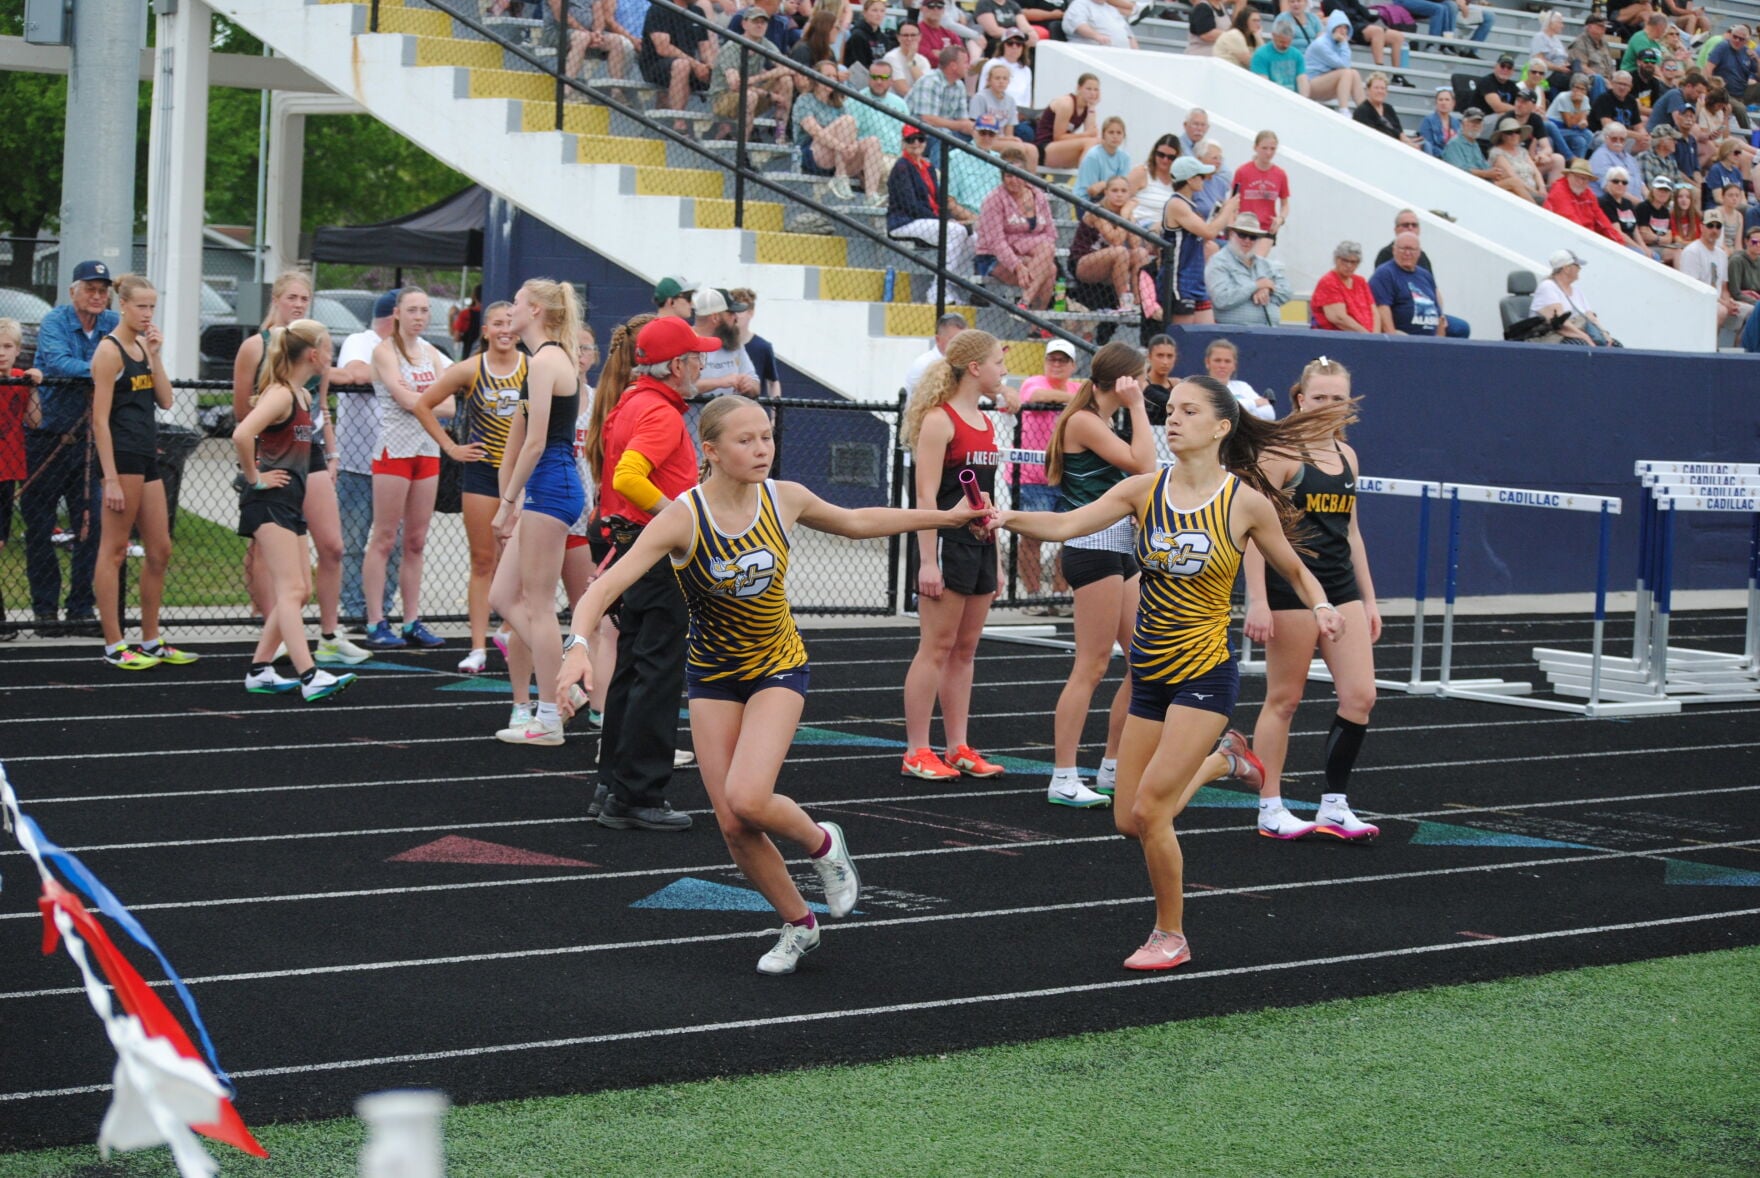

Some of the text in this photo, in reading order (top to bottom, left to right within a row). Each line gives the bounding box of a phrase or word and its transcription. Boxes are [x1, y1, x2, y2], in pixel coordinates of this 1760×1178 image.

[965, 450, 988, 465] LAKE
[1682, 464, 1729, 475] CADILLAC
[1690, 475, 1736, 486] CADILLAC
[1700, 487, 1746, 497] CADILLAC
[1498, 490, 1560, 507] CADILLAC
[1706, 498, 1755, 510] CADILLAC
